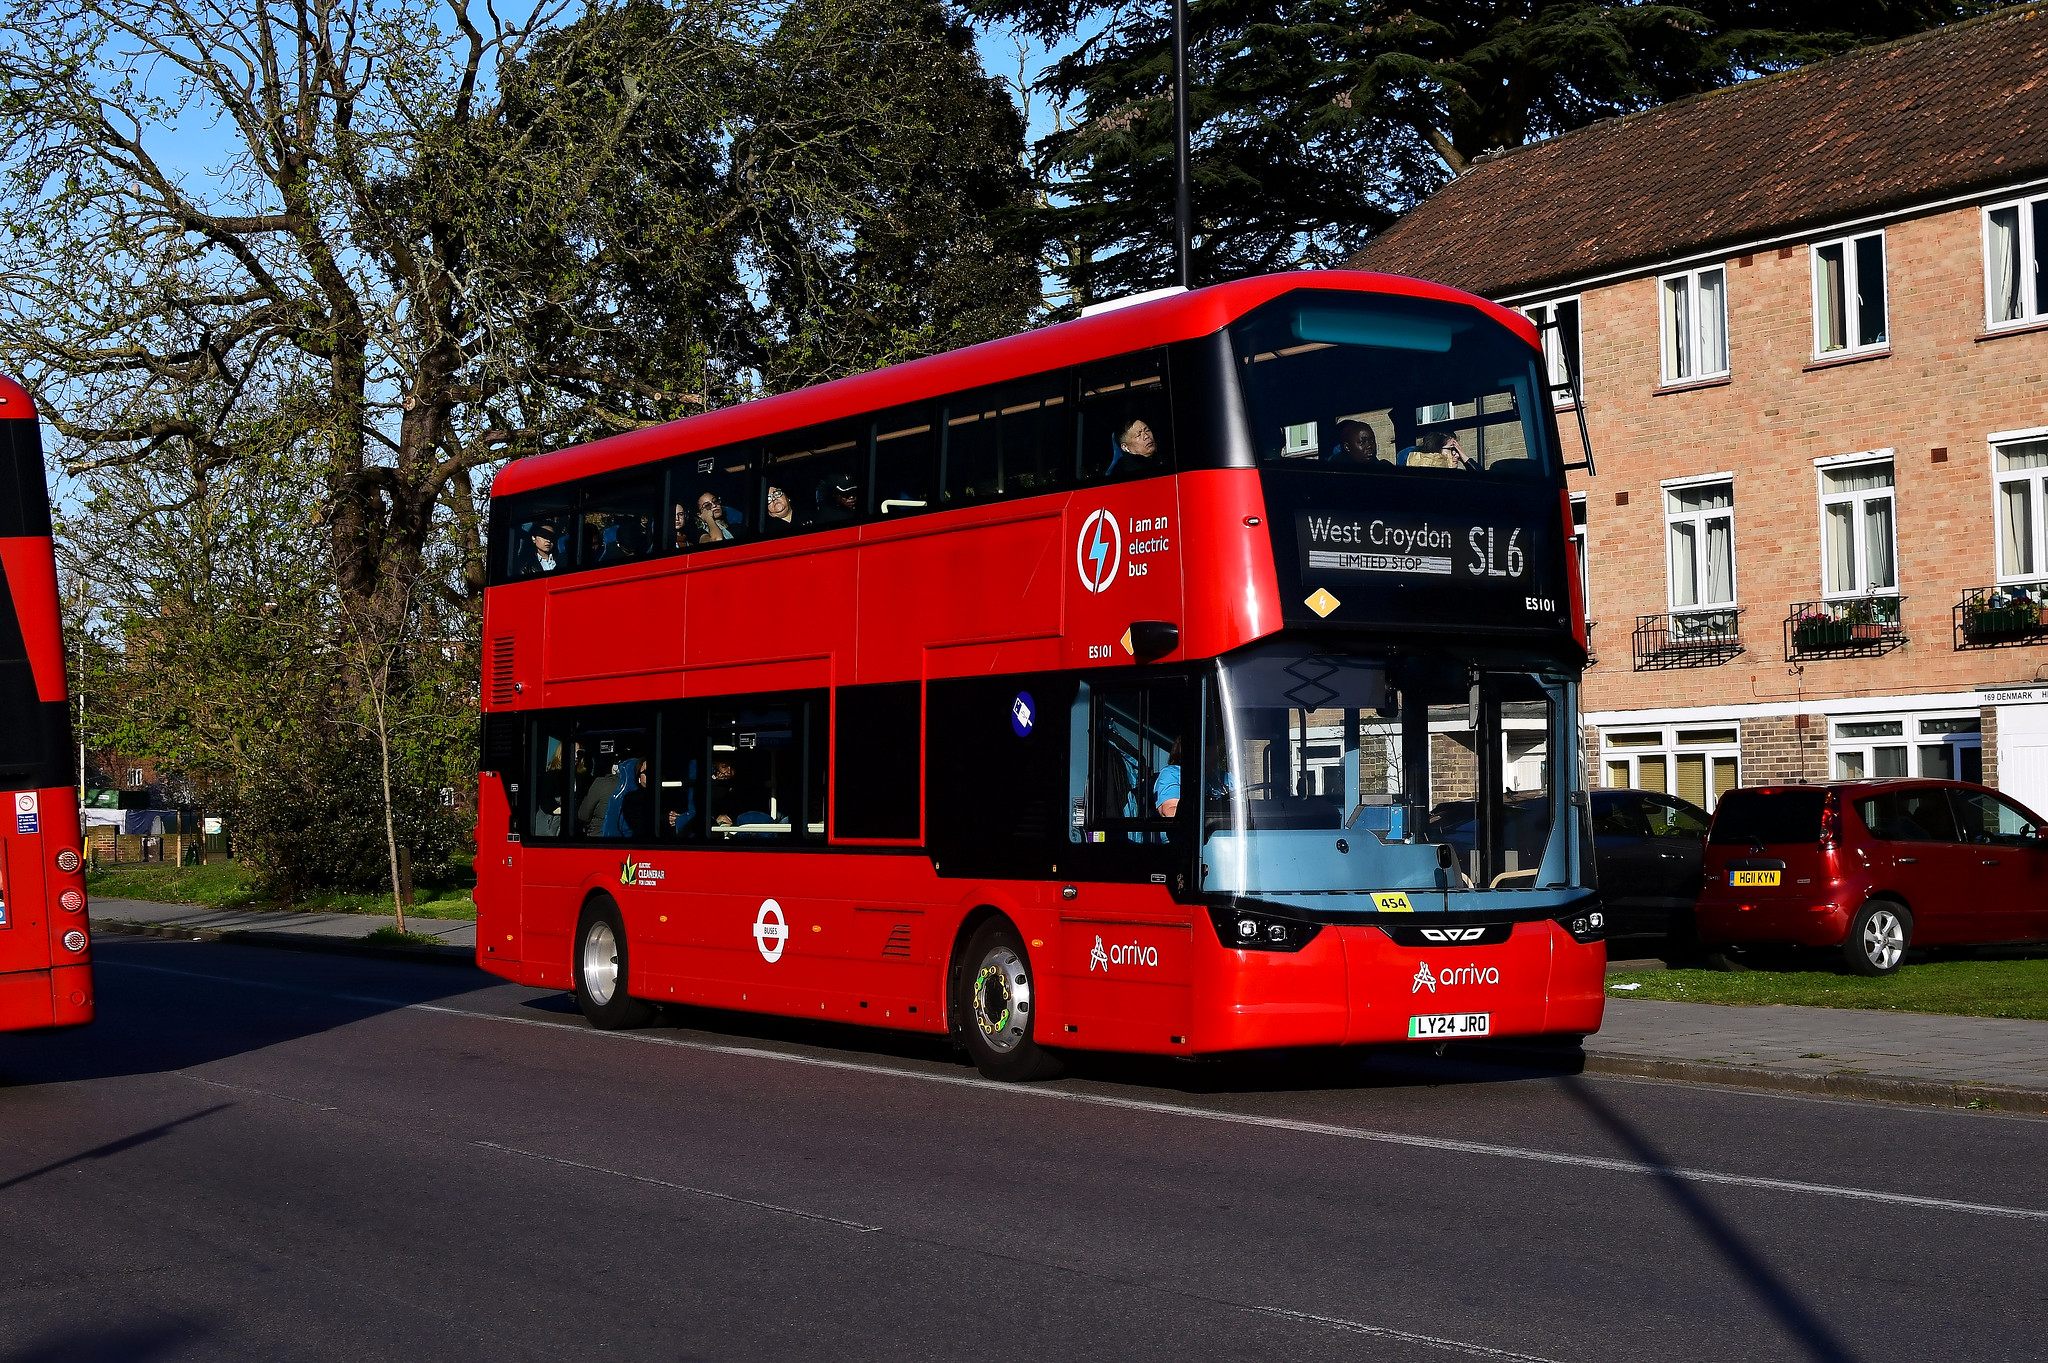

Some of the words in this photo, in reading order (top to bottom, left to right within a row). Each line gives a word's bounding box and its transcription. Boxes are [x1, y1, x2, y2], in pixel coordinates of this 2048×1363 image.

[1129, 517, 1133, 533] I
[1135, 519, 1152, 533] am
[1154, 516, 1168, 530] an
[1308, 515, 1362, 543] West
[1369, 520, 1451, 553] Croydon
[1128, 535, 1170, 555] electric
[1467, 526, 1524, 577] SL6
[1128, 561, 1148, 577] bus
[1338, 553, 1388, 569] LIMITED
[1391, 556, 1422, 571] STOP
[1525, 597, 1555, 612] ES101
[1088, 644, 1112, 659] ES101
[1984, 693, 1995, 701] 169
[1996, 691, 2033, 701] DENMARK
[1740, 872, 1756, 883] HG11
[1757, 872, 1775, 883] KYN
[1381, 898, 1407, 909] 454
[763, 927, 778, 936] BUSES
[1110, 940, 1158, 967] arriva
[1439, 963, 1499, 985] arriva
[1418, 1016, 1455, 1034] LY24
[1460, 1015, 1486, 1032] JRO
